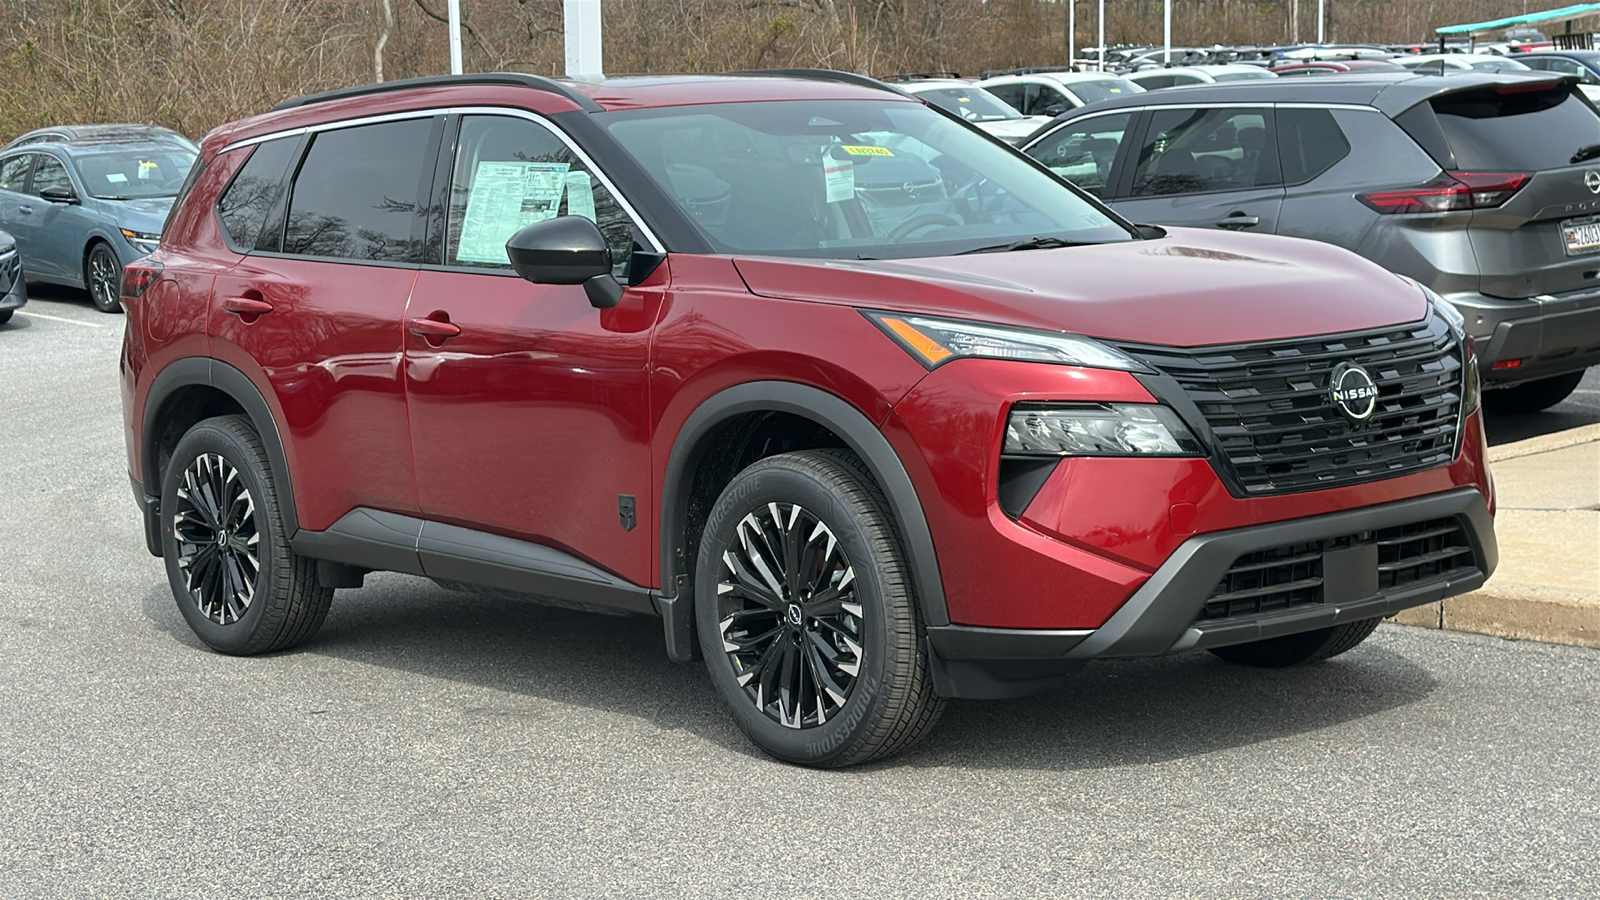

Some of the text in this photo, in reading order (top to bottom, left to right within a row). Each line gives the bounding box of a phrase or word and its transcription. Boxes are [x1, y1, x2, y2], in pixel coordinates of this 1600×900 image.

[1333, 386, 1378, 401] NISSAN
[701, 477, 762, 563] BRIDGESTONE
[805, 673, 878, 757] BRIDGESTONE
